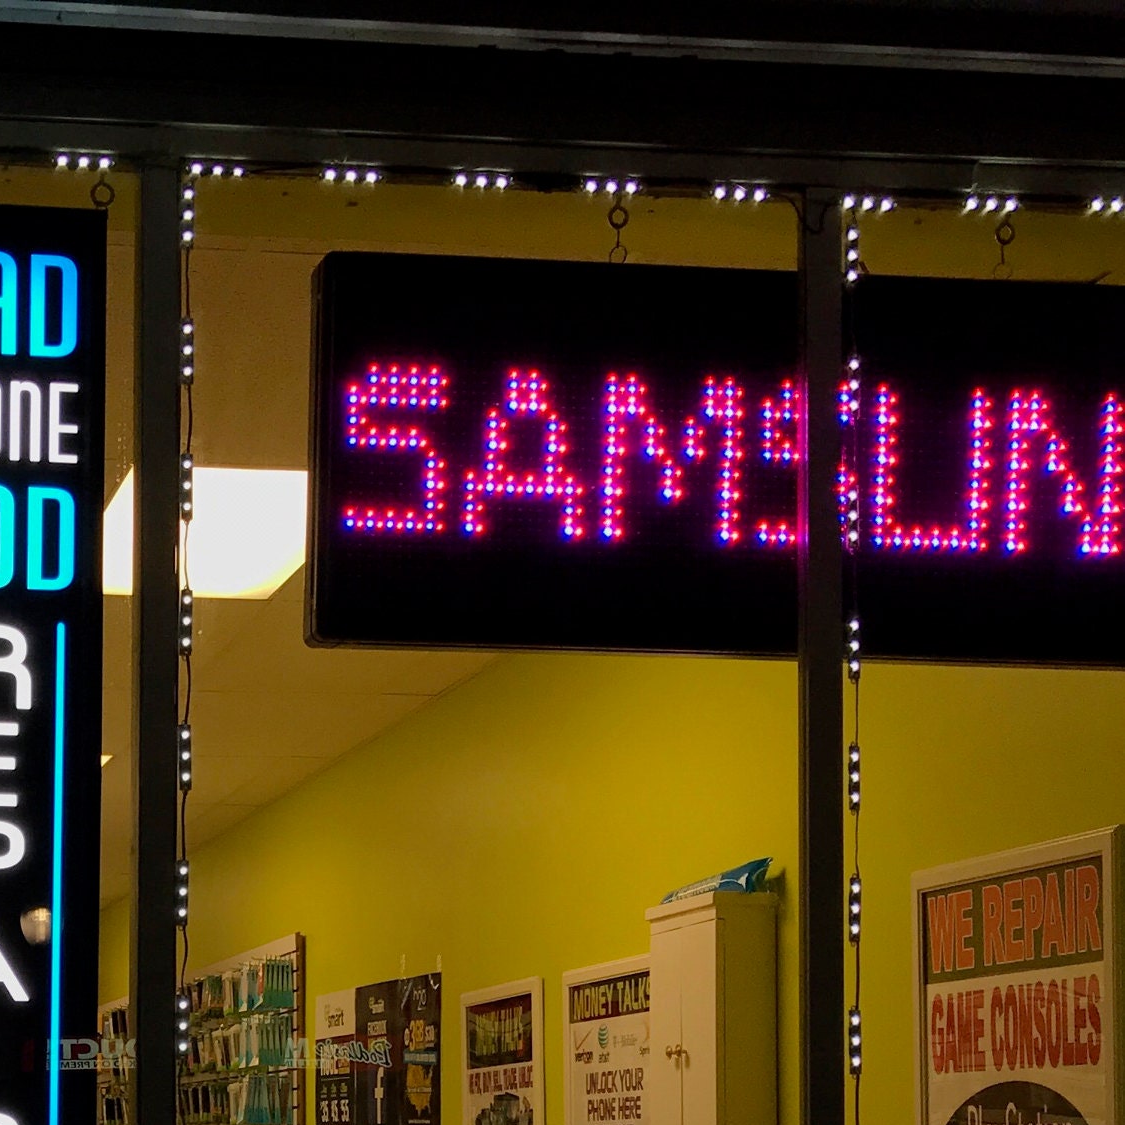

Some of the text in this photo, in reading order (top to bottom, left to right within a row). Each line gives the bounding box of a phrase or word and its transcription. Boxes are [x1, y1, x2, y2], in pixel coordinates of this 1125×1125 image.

[928, 865, 1102, 974] WE REPAIR
[573, 983, 614, 1020] MONEY
[931, 973, 1102, 1075] GAME CONSOLES
[585, 1067, 644, 1094] UNLOCK YOUR
[587, 1096, 642, 1121] PHONE HERE
